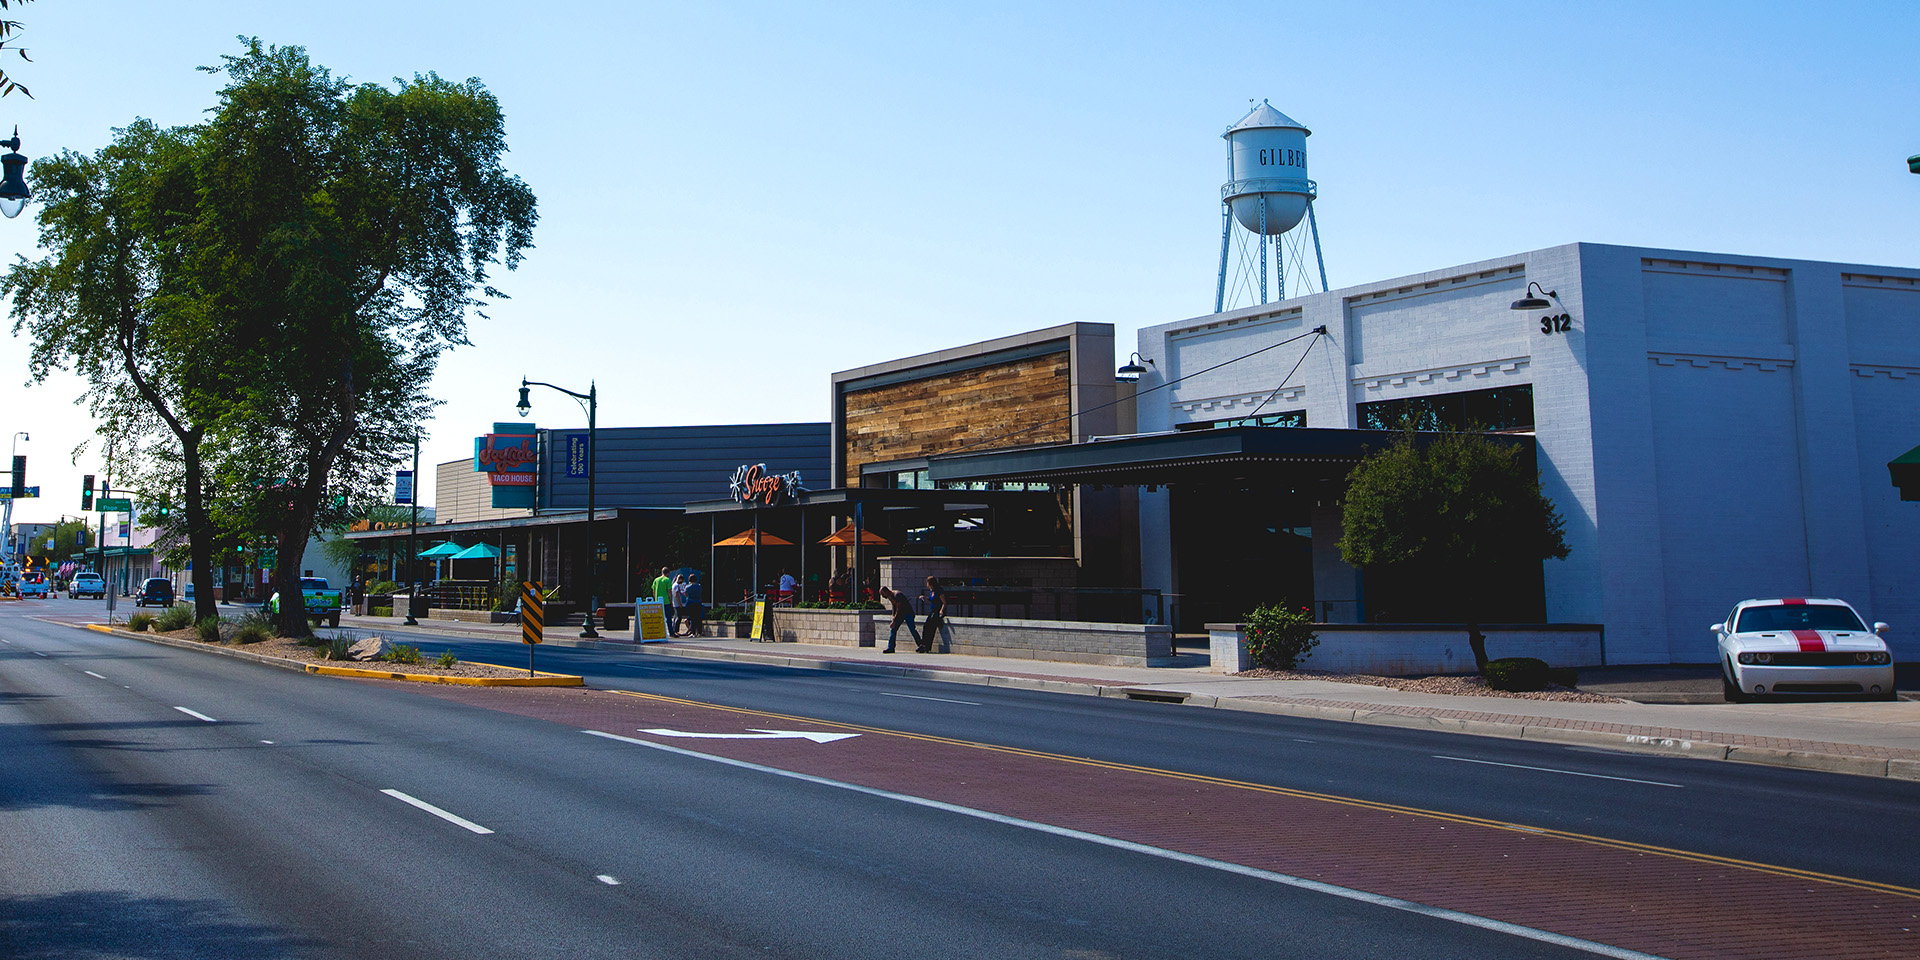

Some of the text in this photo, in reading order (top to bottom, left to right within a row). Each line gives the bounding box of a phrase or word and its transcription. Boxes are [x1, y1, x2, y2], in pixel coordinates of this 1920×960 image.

[1540, 313, 1571, 335] 312
[570, 437, 578, 475] Celebrating
[493, 474, 533, 483] TACO HOUSE
[742, 464, 781, 505] Snooze
